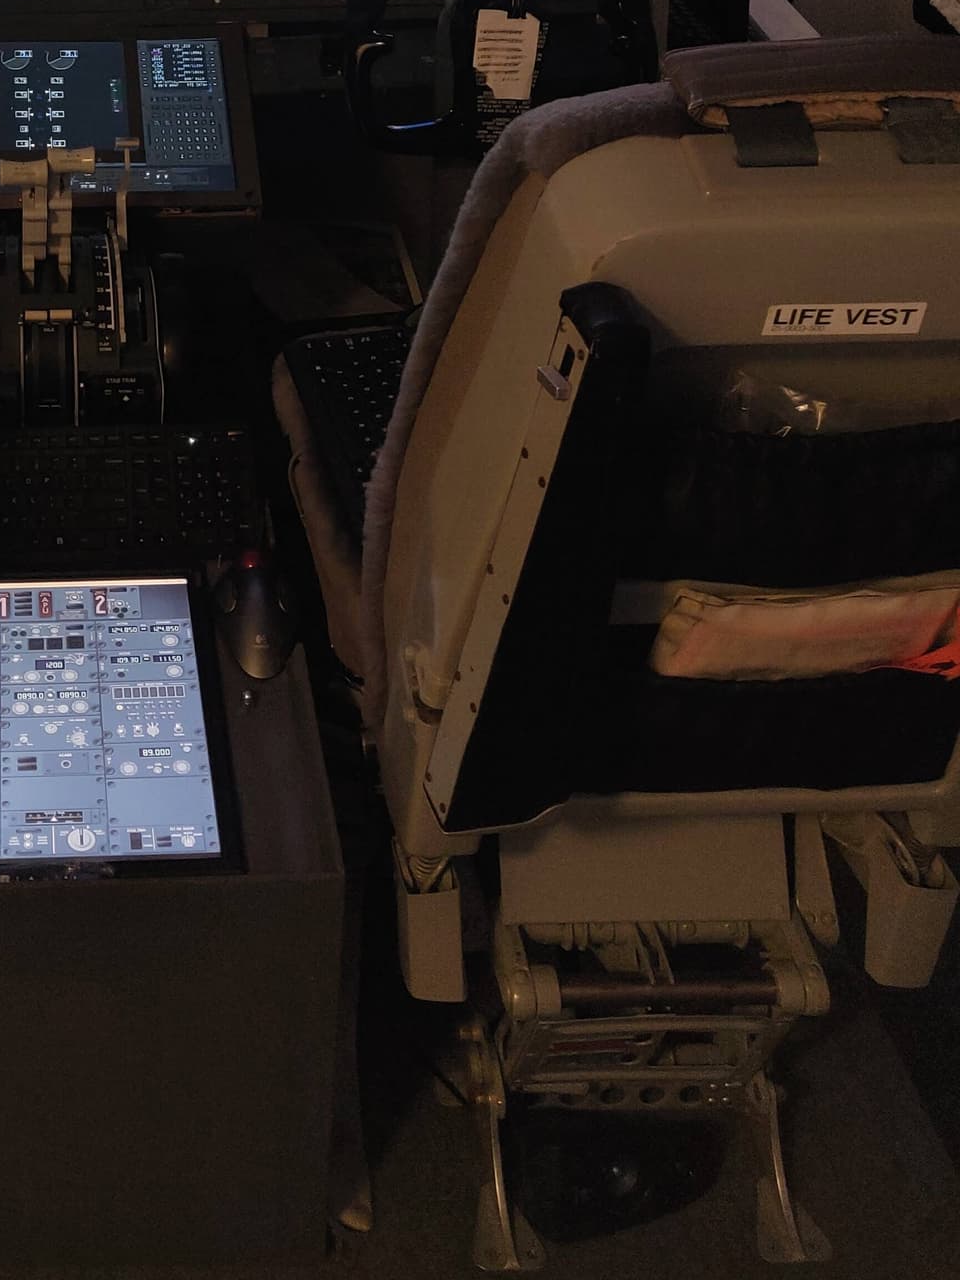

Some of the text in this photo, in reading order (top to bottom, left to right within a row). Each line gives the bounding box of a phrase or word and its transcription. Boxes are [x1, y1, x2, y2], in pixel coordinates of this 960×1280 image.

[773, 308, 918, 325] LIFE VEST
[0, 596, 107, 617] 1 2
[46, 661, 63, 669] 1200
[142, 748, 171, 757] 89.000
